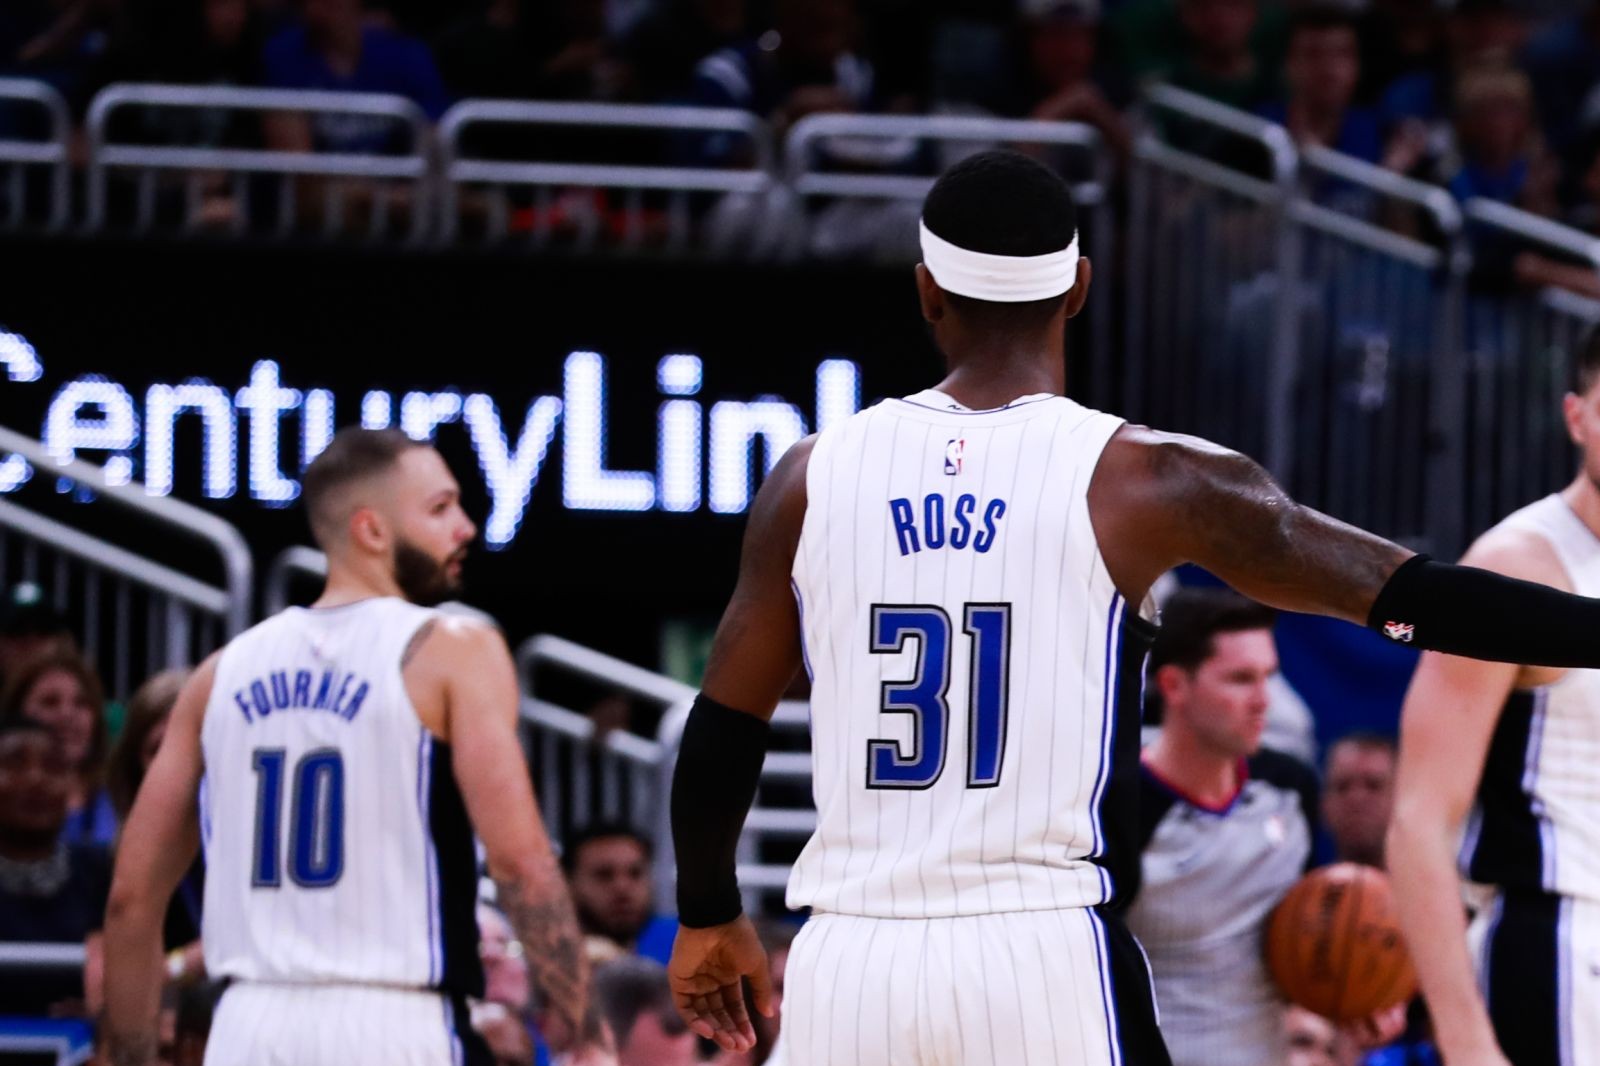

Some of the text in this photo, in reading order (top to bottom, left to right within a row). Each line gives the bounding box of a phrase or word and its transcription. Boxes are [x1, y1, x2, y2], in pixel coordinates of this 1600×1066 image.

[0, 326, 861, 550] enturyLin
[888, 492, 1006, 556] ROSS
[865, 602, 1012, 791] 31
[251, 747, 344, 889] 10
